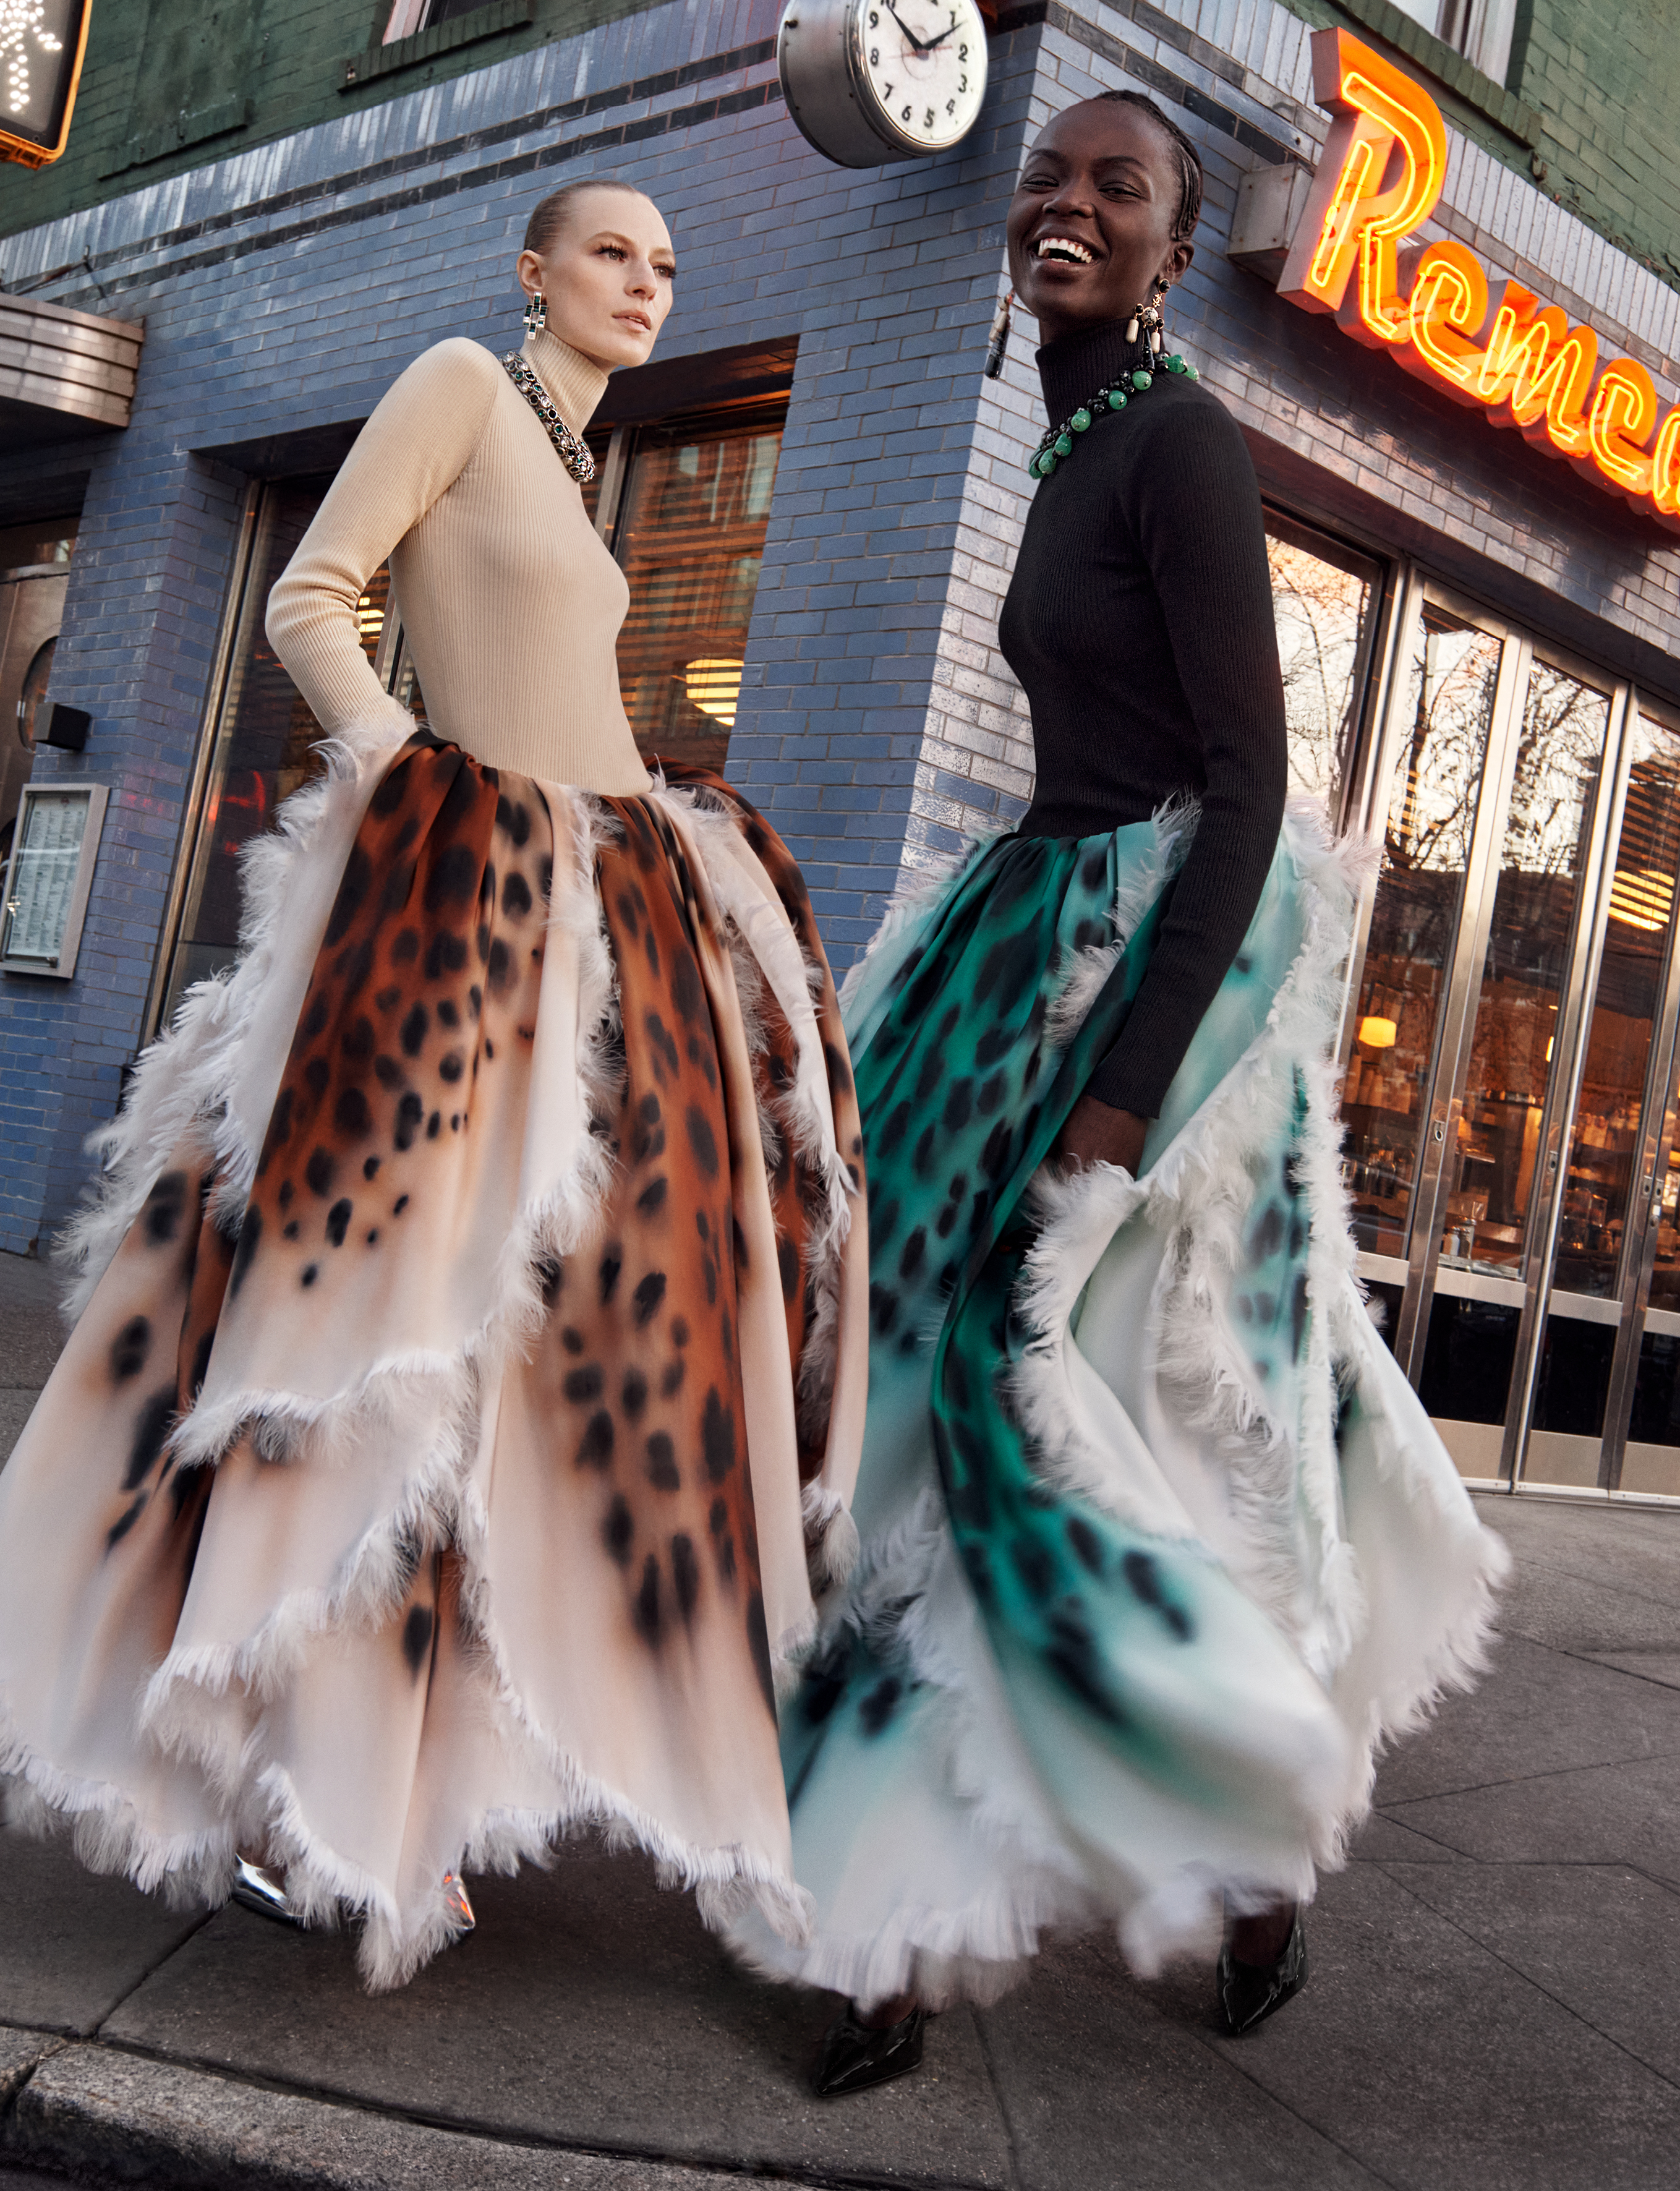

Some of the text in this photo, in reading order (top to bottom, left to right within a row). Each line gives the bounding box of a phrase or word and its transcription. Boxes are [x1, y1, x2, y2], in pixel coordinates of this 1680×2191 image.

[869, 11, 879, 29] 9
[949, 11, 956, 28] 1
[870, 48, 879, 67] 8
[958, 44, 968, 62] 2
[884, 82, 894, 101] 7
[958, 73, 968, 93] 3
[901, 105, 912, 121] 6
[946, 98, 955, 116] 4
[924, 107, 935, 127] 5
